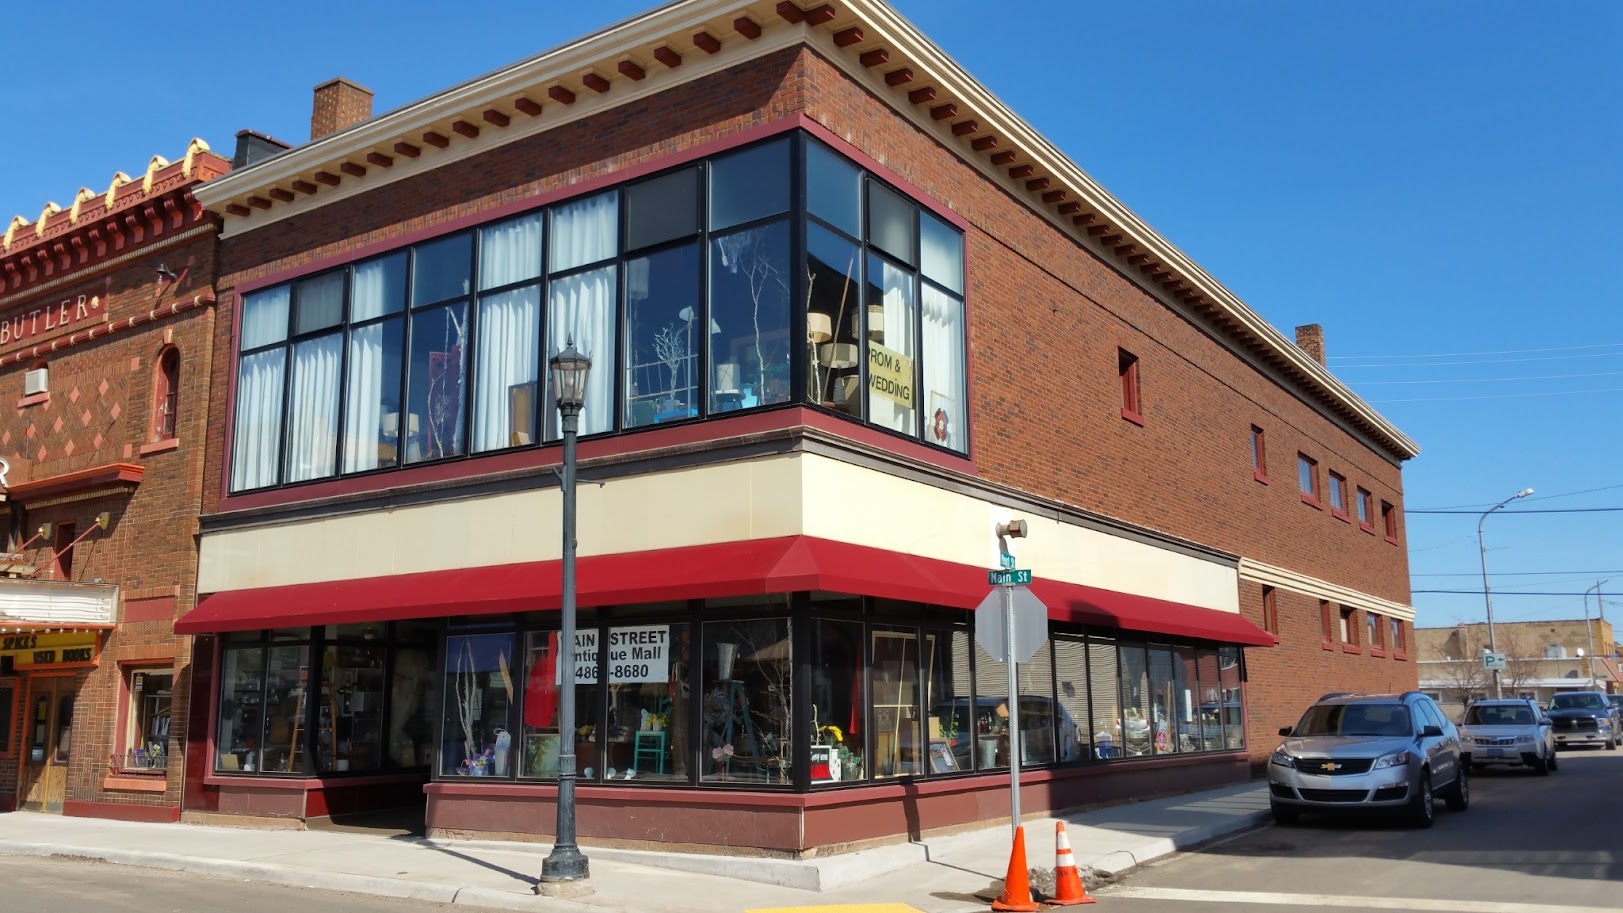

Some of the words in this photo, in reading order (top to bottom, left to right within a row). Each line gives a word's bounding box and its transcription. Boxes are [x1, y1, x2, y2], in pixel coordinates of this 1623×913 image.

[0, 294, 88, 345] BUTLER
[868, 348, 892, 370] ROM
[894, 358, 901, 373] &
[990, 572, 1012, 584] Main
[1017, 571, 1028, 583] St
[610, 630, 667, 646] STREET
[33, 650, 56, 664] USED
[62, 647, 92, 663] BOOKS
[632, 646, 661, 661] Mall
[1485, 655, 1495, 667] P
